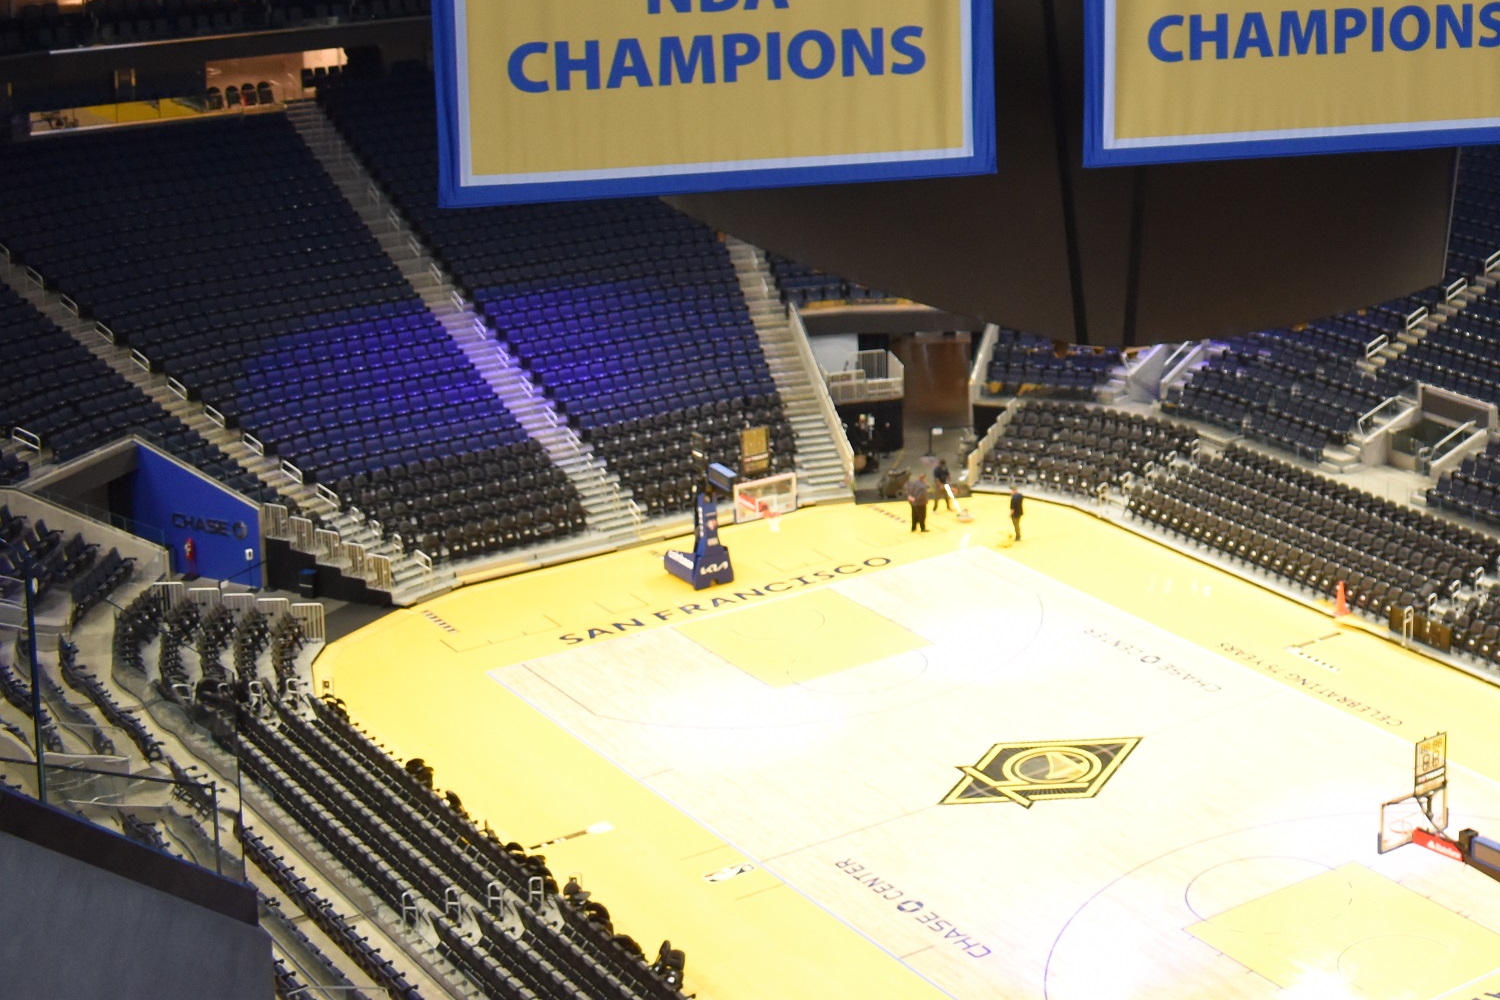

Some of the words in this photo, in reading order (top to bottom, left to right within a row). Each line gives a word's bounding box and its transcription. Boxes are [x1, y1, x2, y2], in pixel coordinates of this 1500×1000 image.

[506, 25, 927, 93] CHAMPIONS
[171, 512, 230, 537] CHASE
[559, 618, 645, 645] SAN
[652, 556, 892, 622] FRANCISCO
[1158, 661, 1222, 693] CHASE
[1284, 672, 1403, 727] CELEBRATING
[835, 858, 904, 900] CENTER
[915, 911, 992, 958] CHASE
